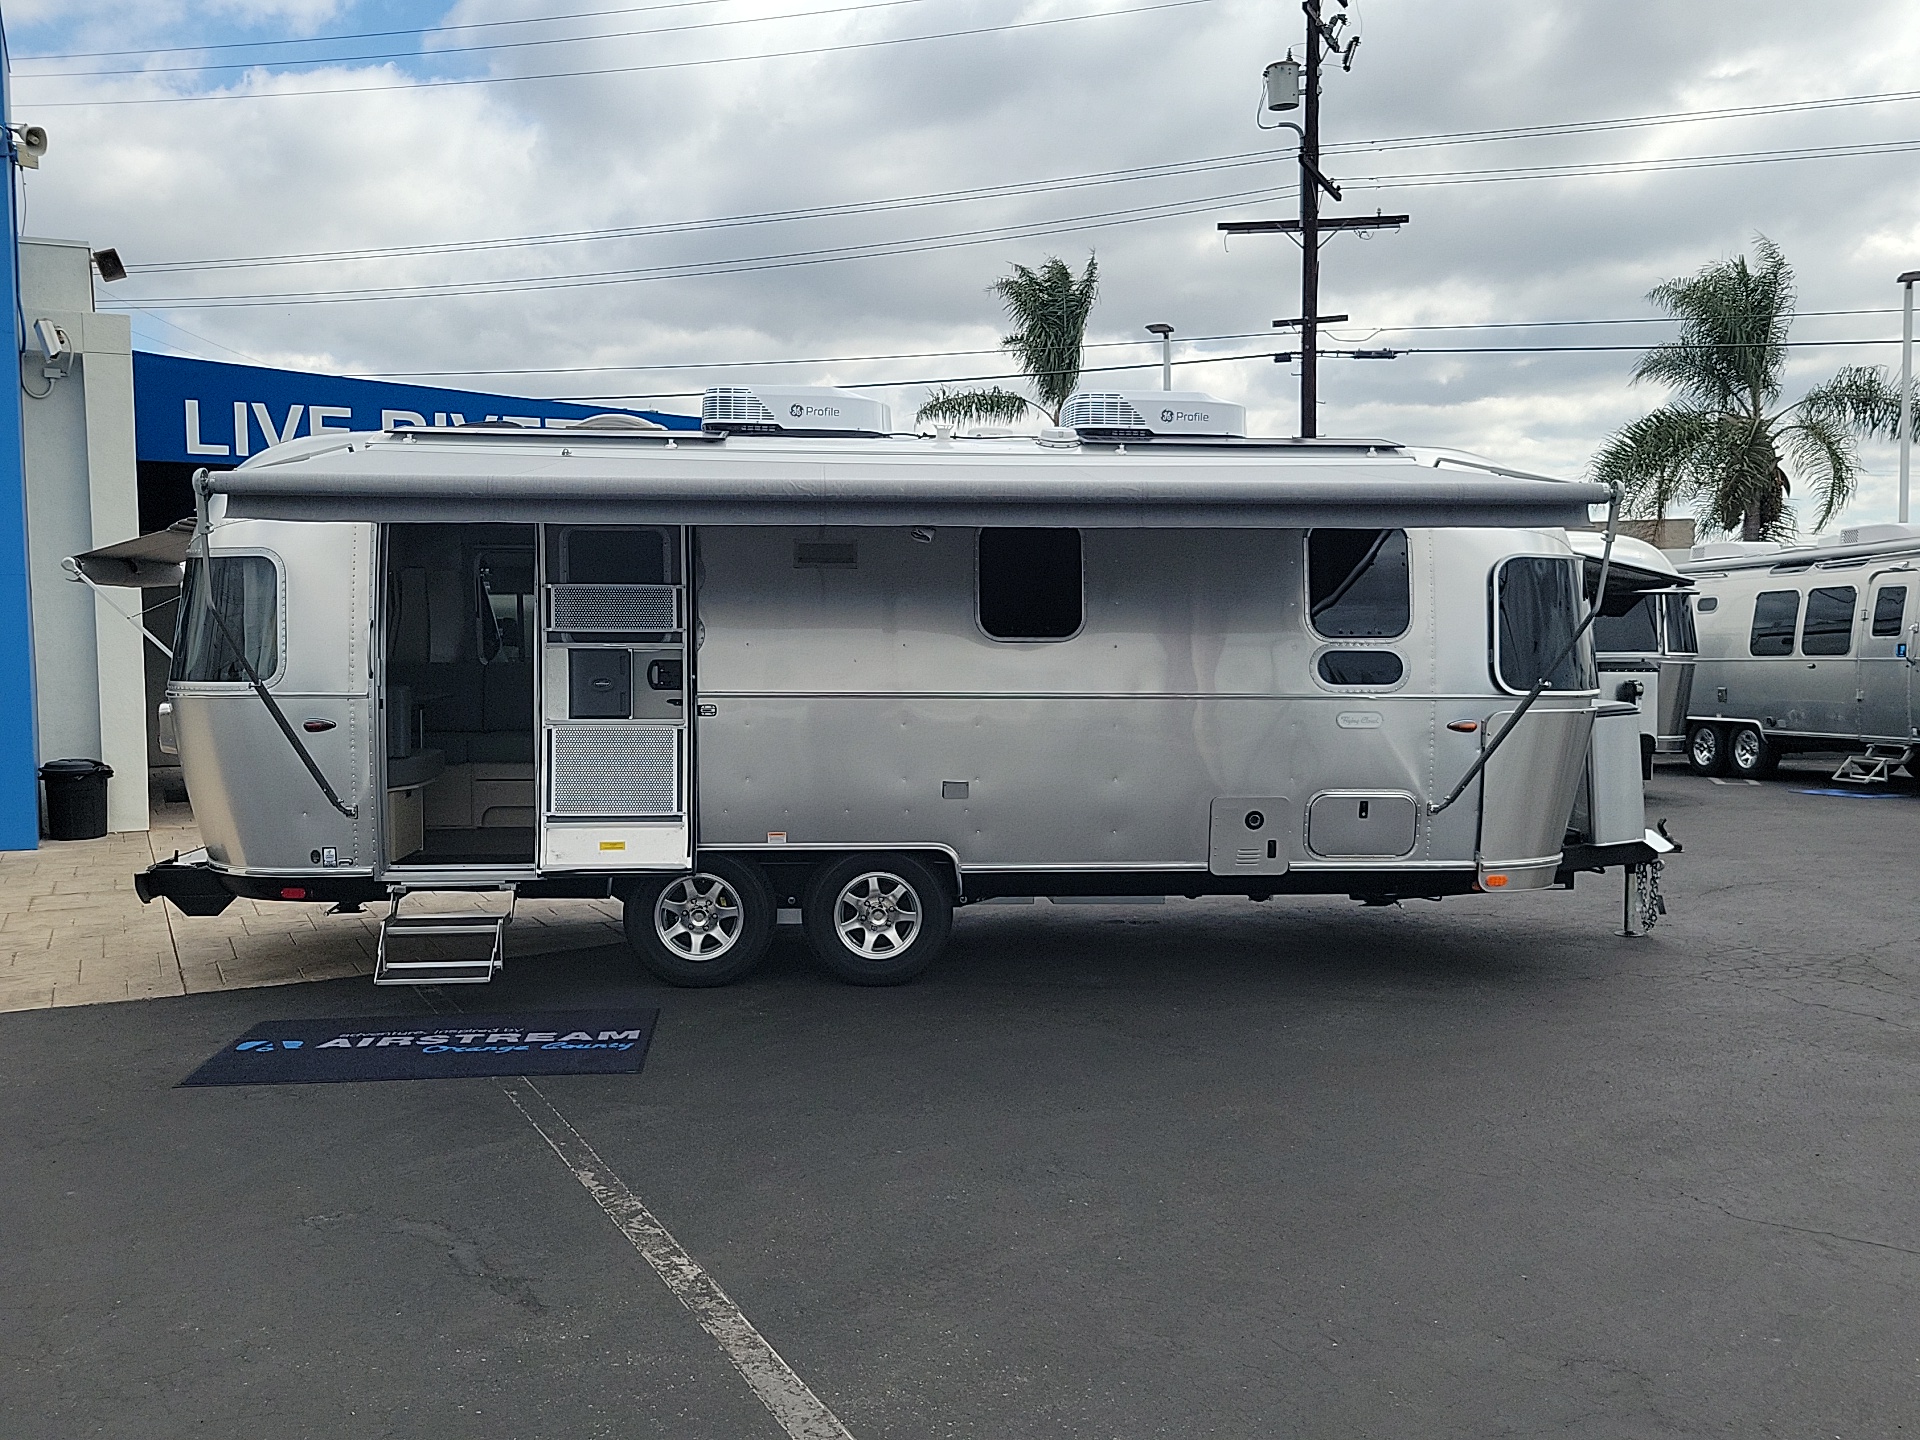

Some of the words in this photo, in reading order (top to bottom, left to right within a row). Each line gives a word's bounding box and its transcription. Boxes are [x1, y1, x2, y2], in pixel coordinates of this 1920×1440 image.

[806, 406, 840, 417] Profile
[1176, 411, 1209, 422] Profile
[315, 1030, 640, 1049] AIRSTREAM
[422, 1045, 529, 1054] Orange
[540, 1041, 634, 1051] County
